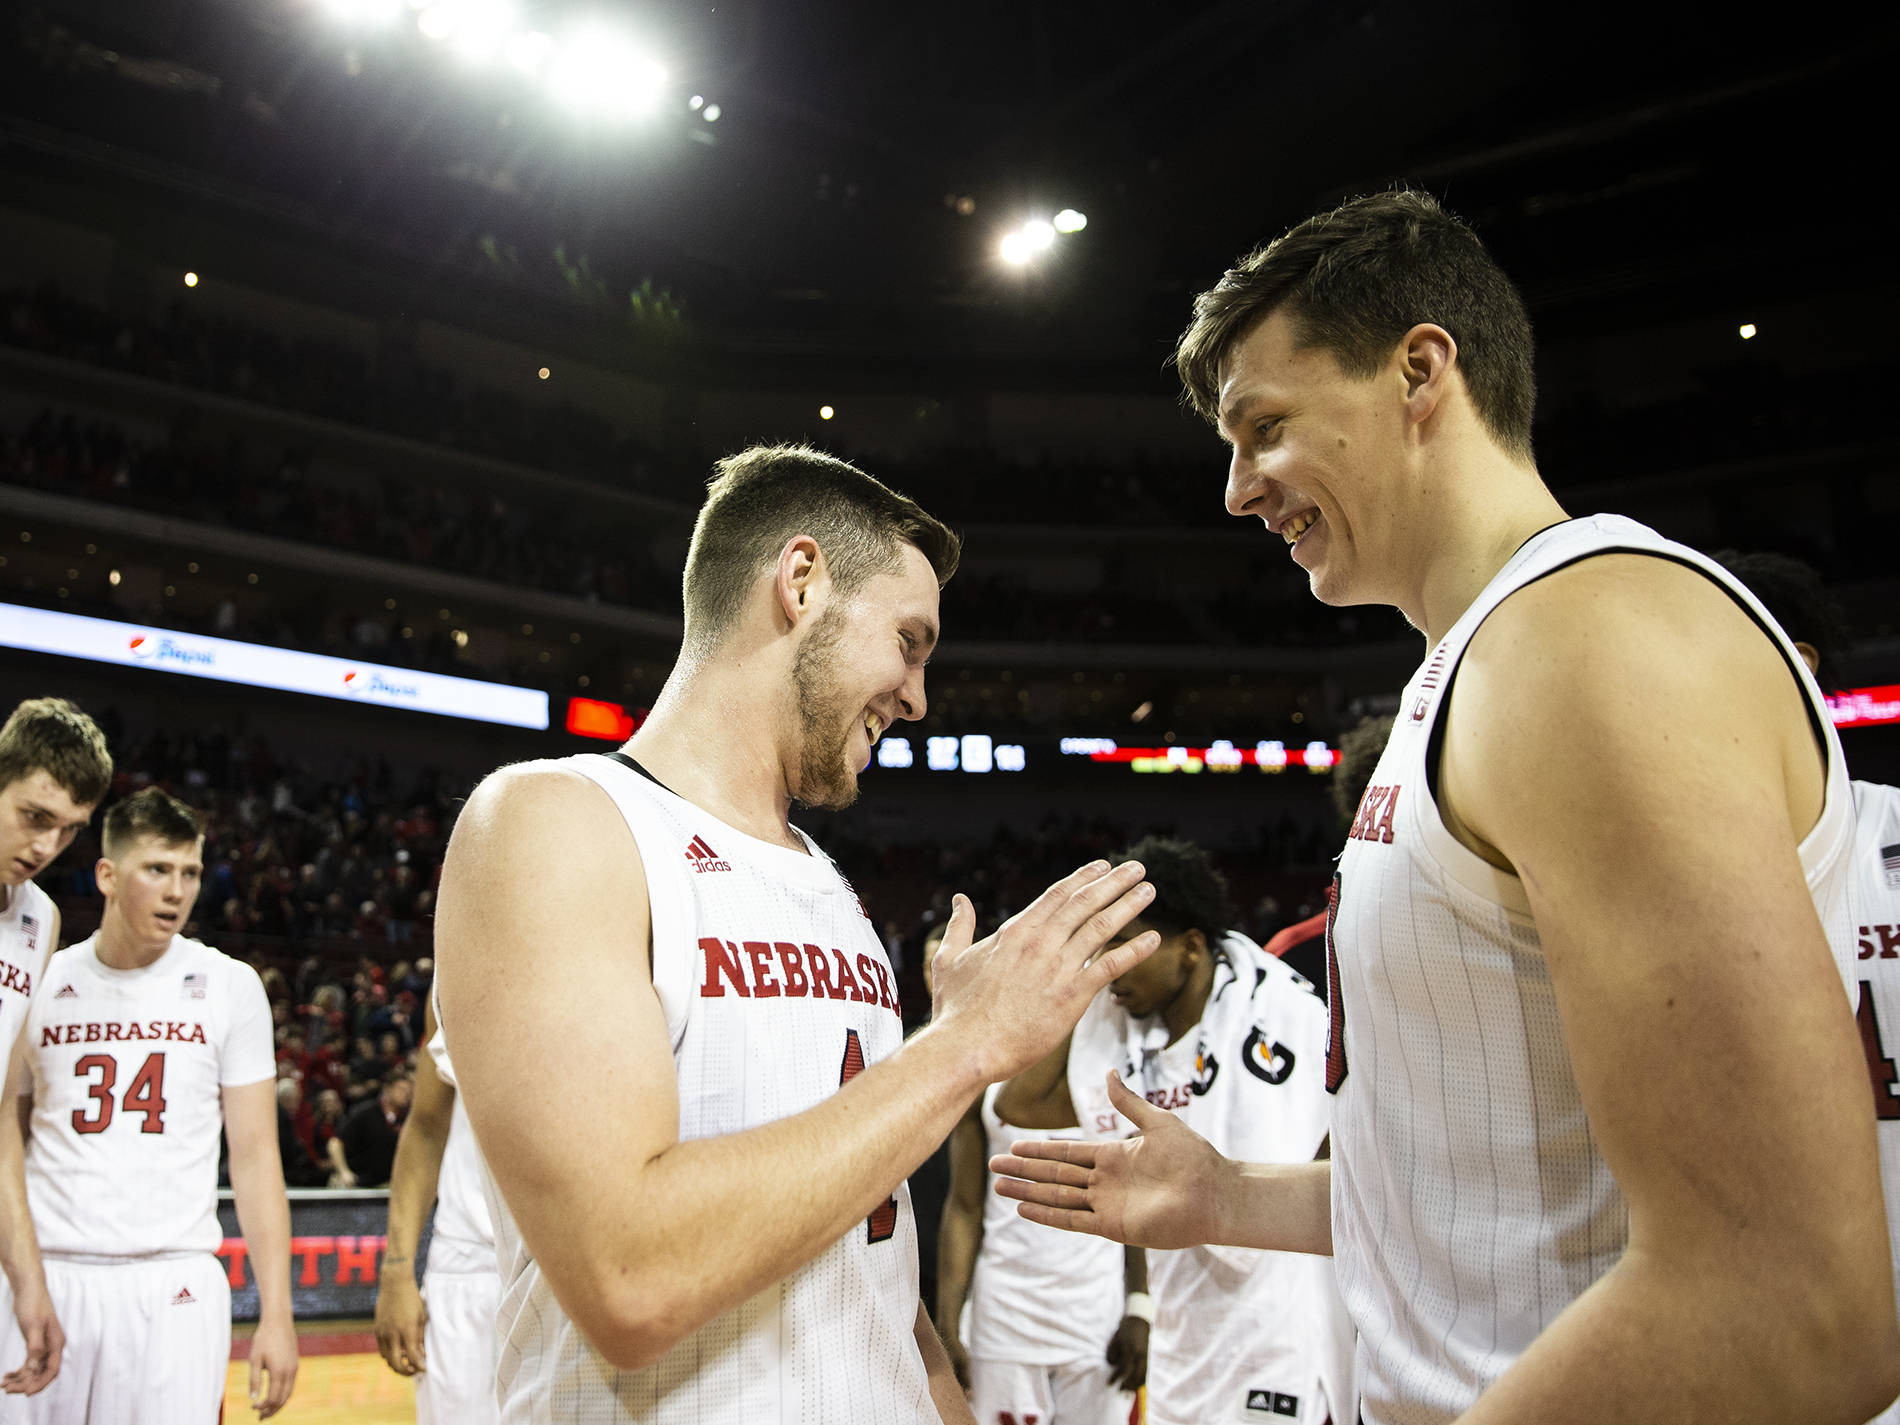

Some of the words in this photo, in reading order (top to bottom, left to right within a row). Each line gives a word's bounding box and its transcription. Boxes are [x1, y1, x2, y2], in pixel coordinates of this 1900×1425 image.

[691, 858, 732, 873] didas
[698, 937, 902, 1018] NEBRASK
[41, 1021, 207, 1048] NEBRASKA
[71, 1052, 167, 1134] 34
